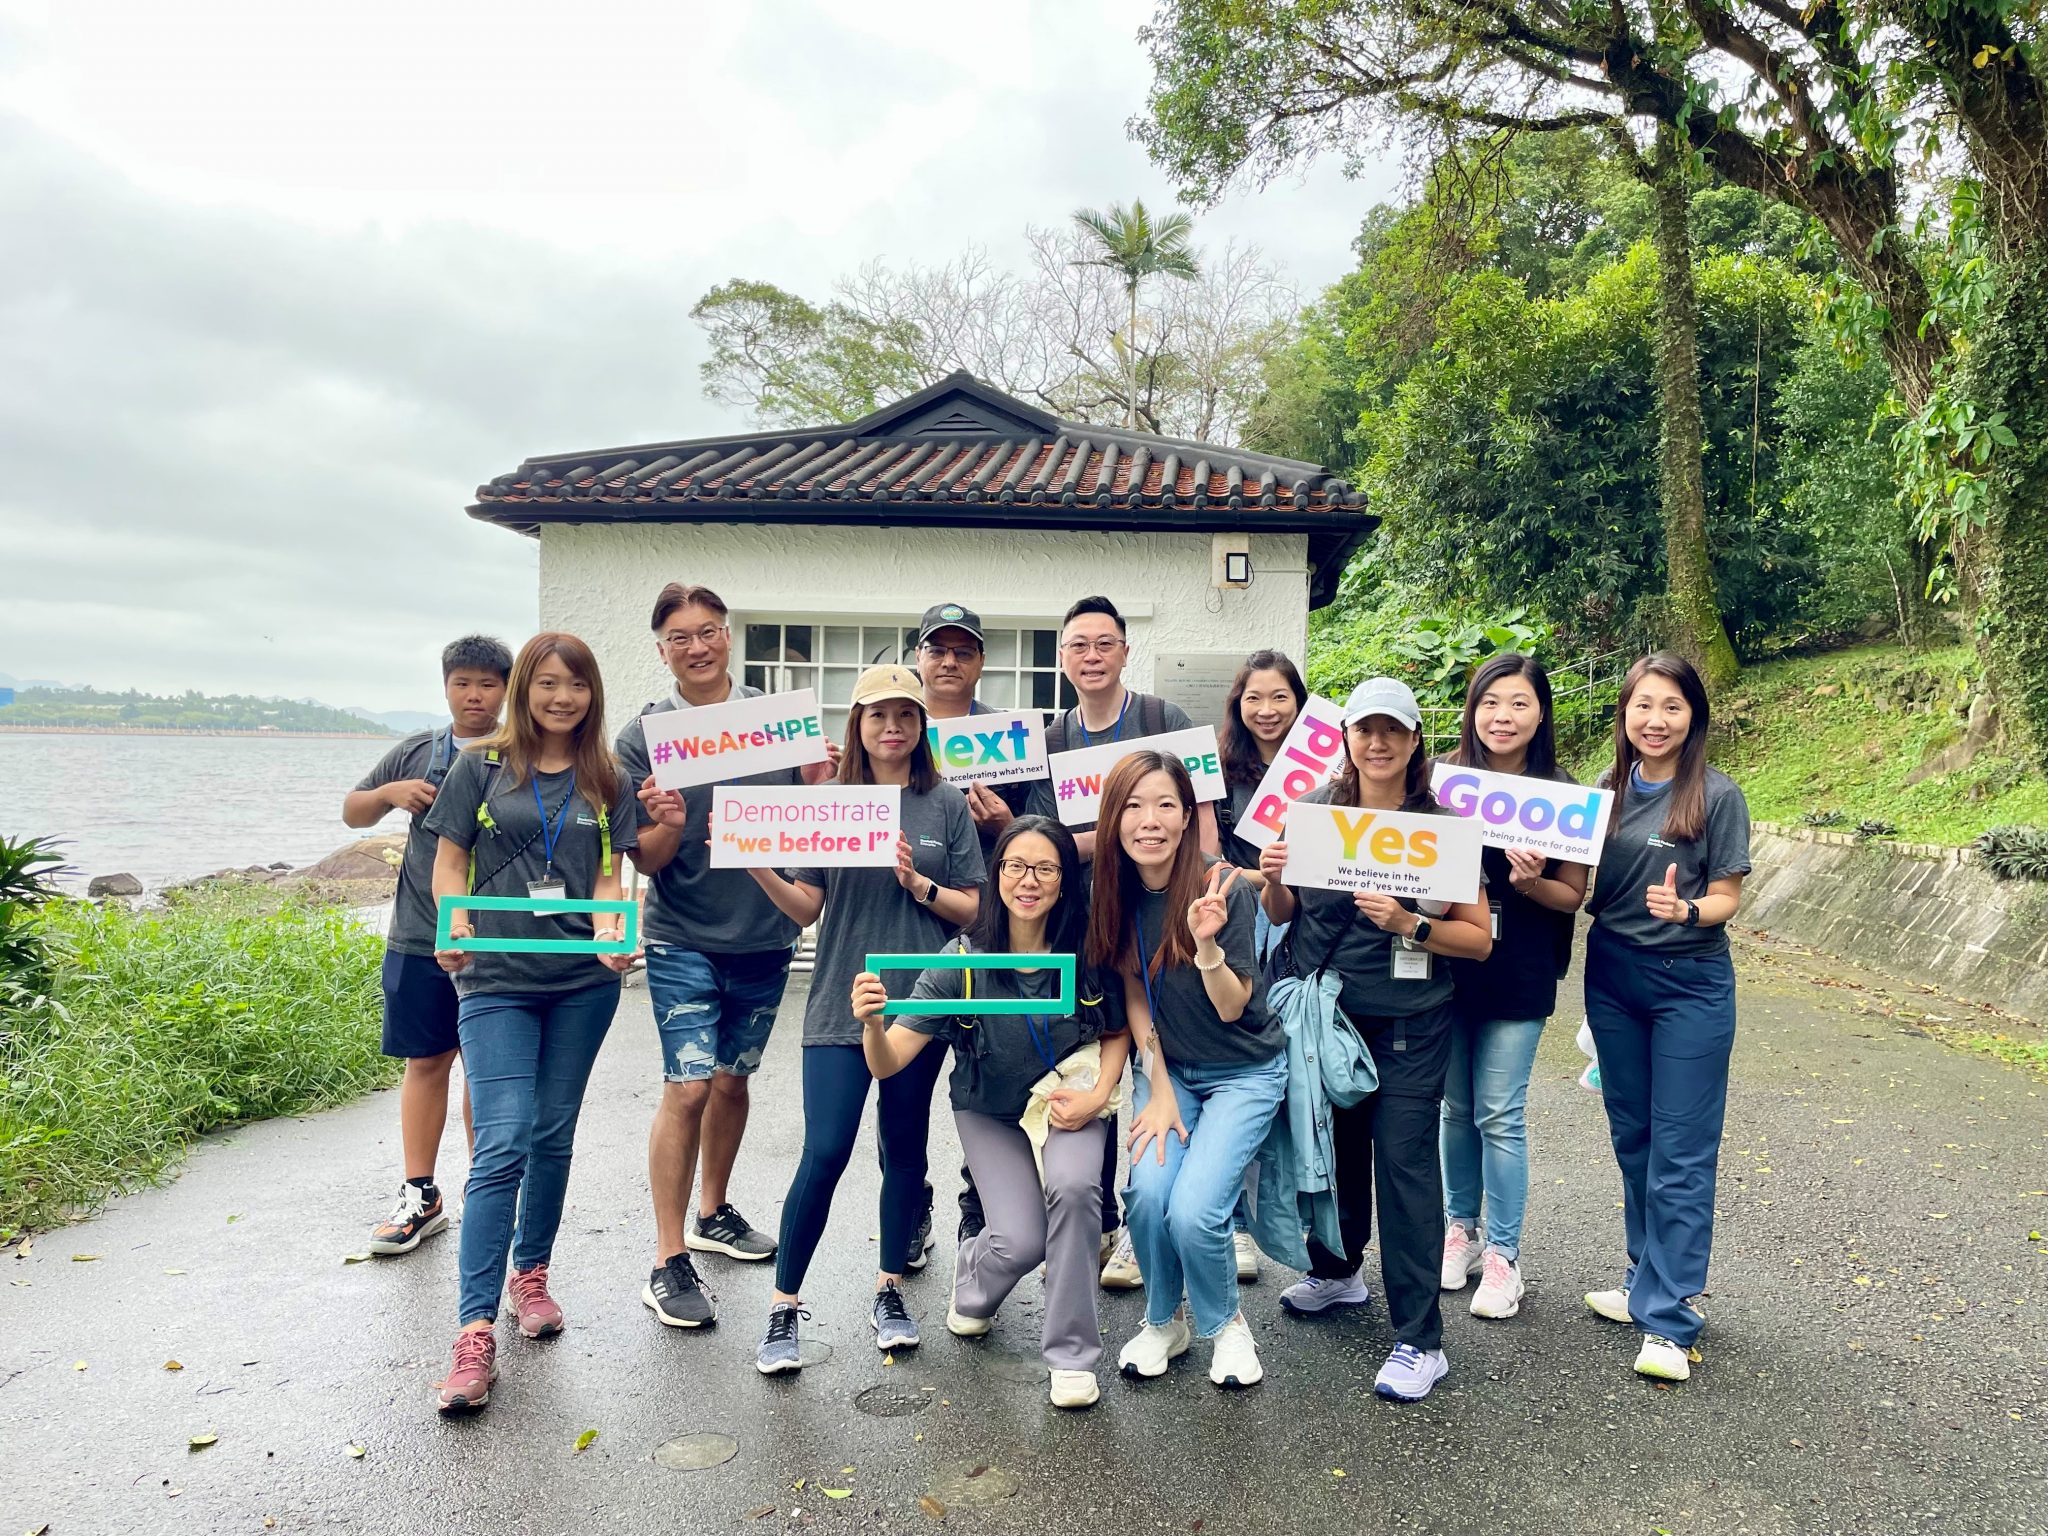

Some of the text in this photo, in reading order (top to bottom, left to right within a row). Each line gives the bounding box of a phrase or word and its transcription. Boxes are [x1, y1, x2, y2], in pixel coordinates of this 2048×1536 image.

[653, 715, 821, 765] #WeAreHPE
[949, 770, 997, 783] accelerating
[999, 766, 1025, 776] what's
[723, 800, 890, 823] Demonstrate
[1439, 773, 1602, 841] Good
[779, 831, 862, 853] before
[1331, 810, 1438, 868] Yes
[1490, 830, 1515, 843] being
[1524, 837, 1548, 848] force
[1549, 841, 1563, 850] for
[1565, 845, 1589, 855] good
[1328, 878, 1357, 887] power
[1360, 880, 1370, 888] of
[1338, 866, 1420, 882] We believe in the
